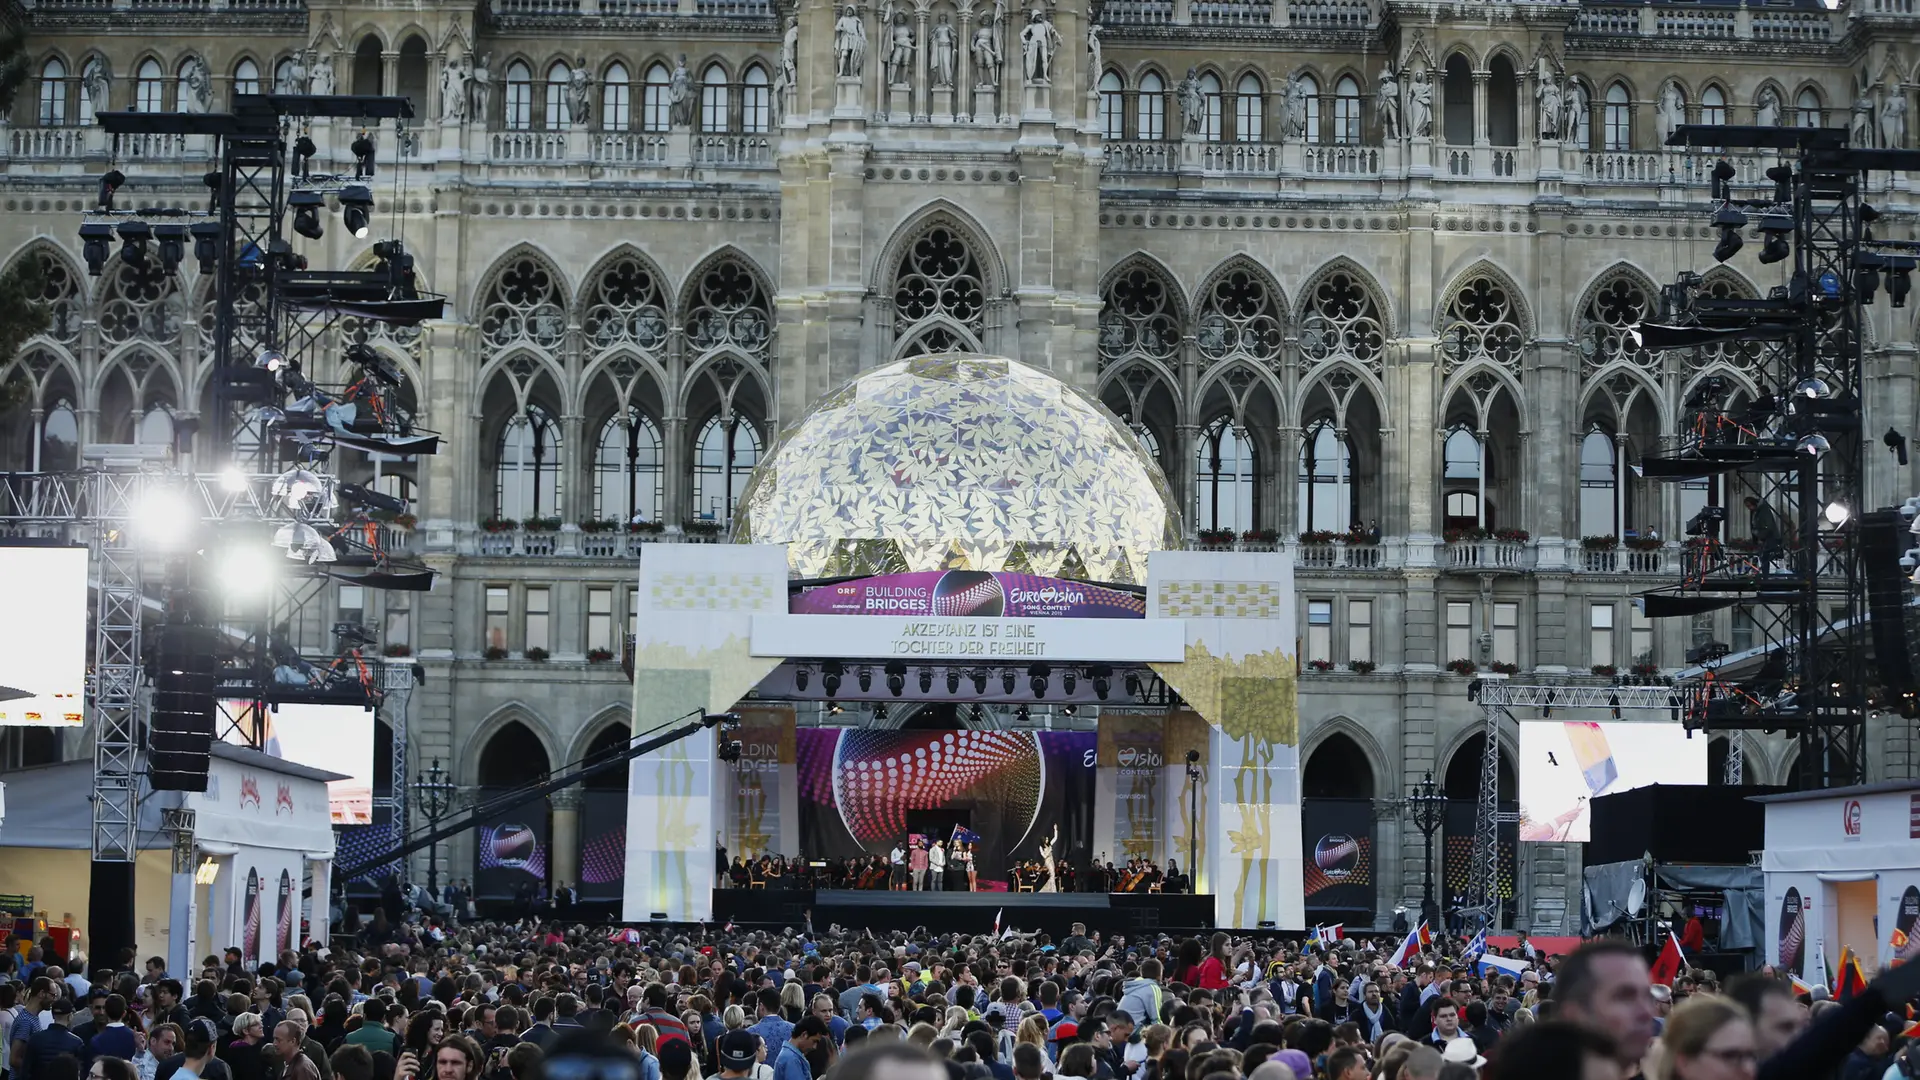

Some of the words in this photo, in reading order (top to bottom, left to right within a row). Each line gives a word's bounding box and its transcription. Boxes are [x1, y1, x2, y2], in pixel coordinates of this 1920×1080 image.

[865, 587, 927, 597] BUILDING
[865, 599, 927, 610] BRIDGES
[902, 623, 976, 637] AKZEPTANZ
[982, 624, 999, 637] IST
[1005, 624, 1035, 638] EINE
[891, 640, 953, 654] TOCHTER
[959, 641, 984, 655] DER
[990, 641, 1046, 655] FREIHEIT
[739, 788, 761, 796] ORF
